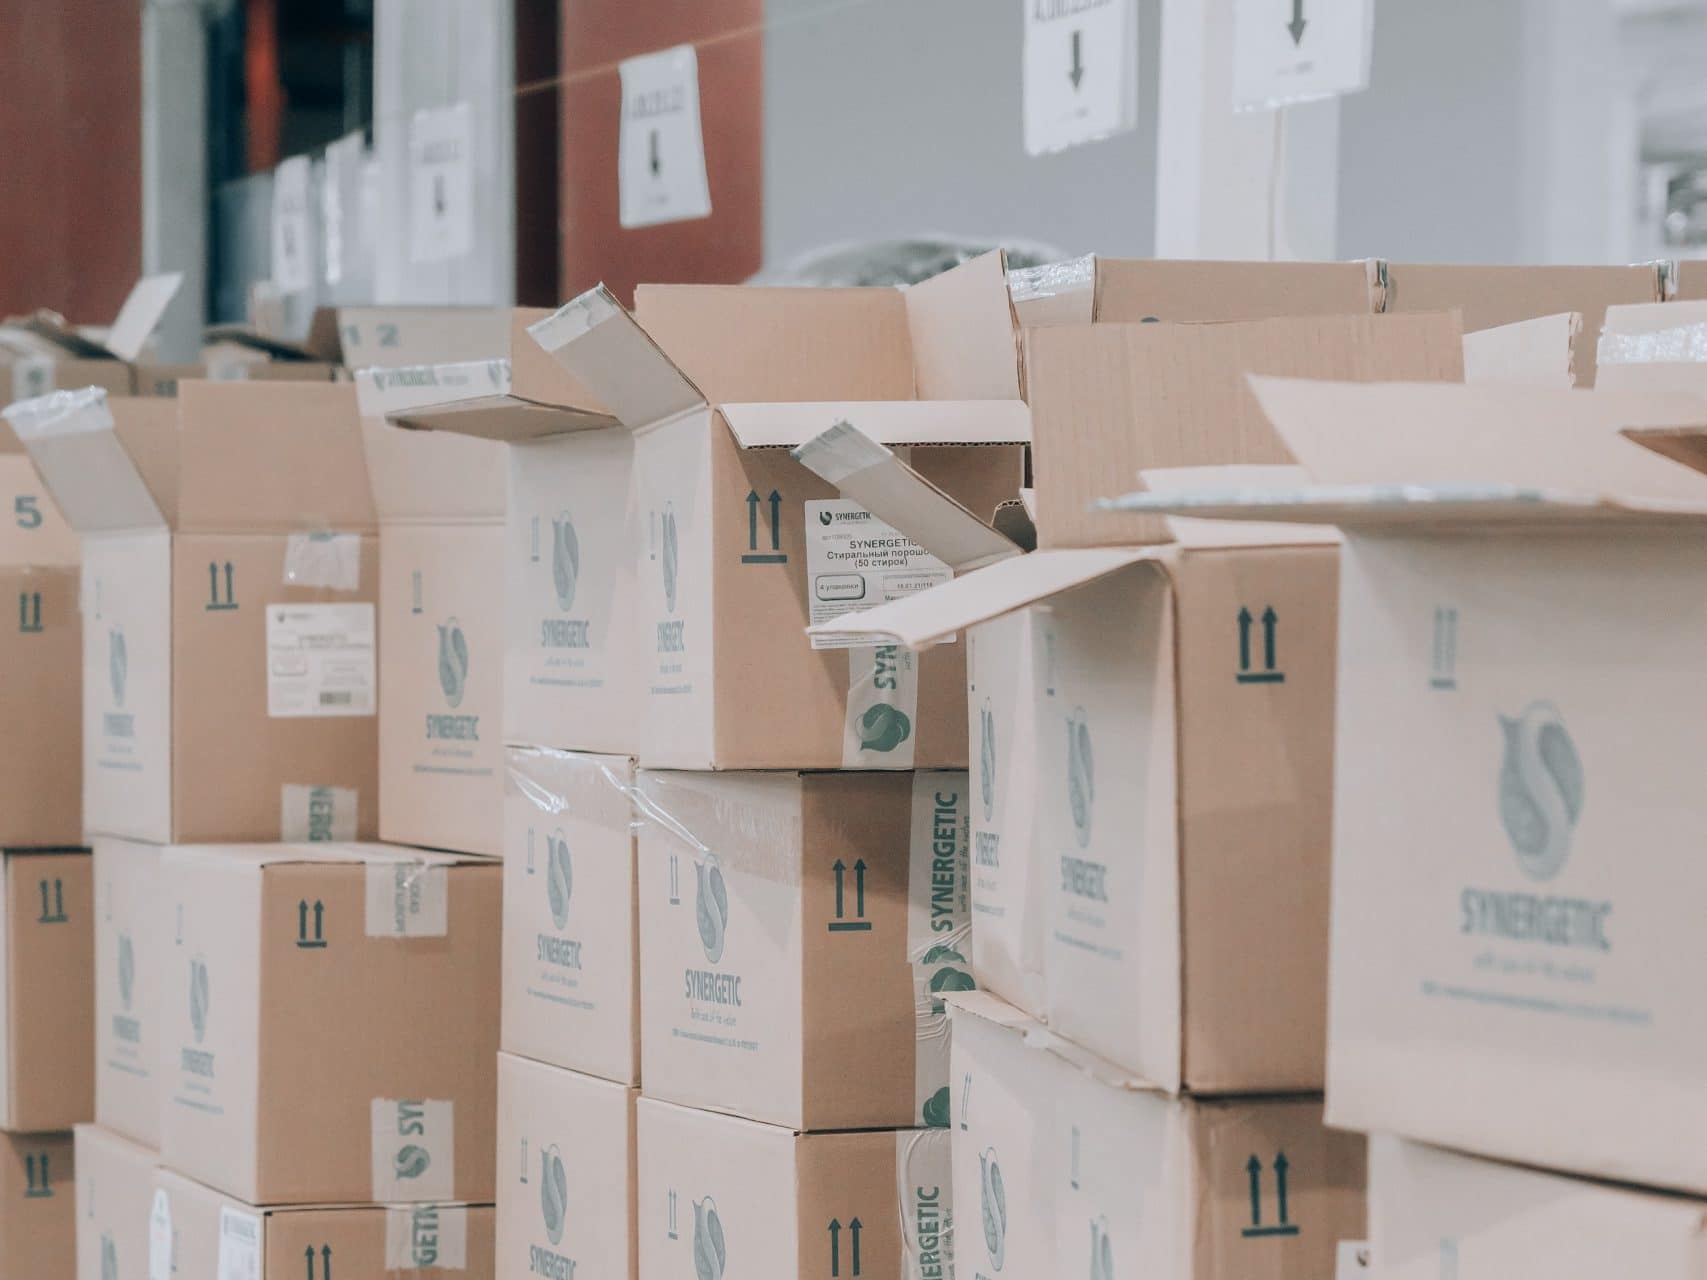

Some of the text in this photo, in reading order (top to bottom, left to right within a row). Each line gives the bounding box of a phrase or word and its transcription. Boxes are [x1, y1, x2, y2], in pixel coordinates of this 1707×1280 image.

[15, 495, 43, 528] 5
[835, 511, 872, 521] SYNERGETIC
[827, 550, 889, 561] Стиральный
[854, 557, 908, 569] (50 стирок)
[931, 791, 958, 933] SYNERGETIC
[537, 933, 582, 970] SYNERGETIC
[685, 968, 742, 1007] SYNERGETIC
